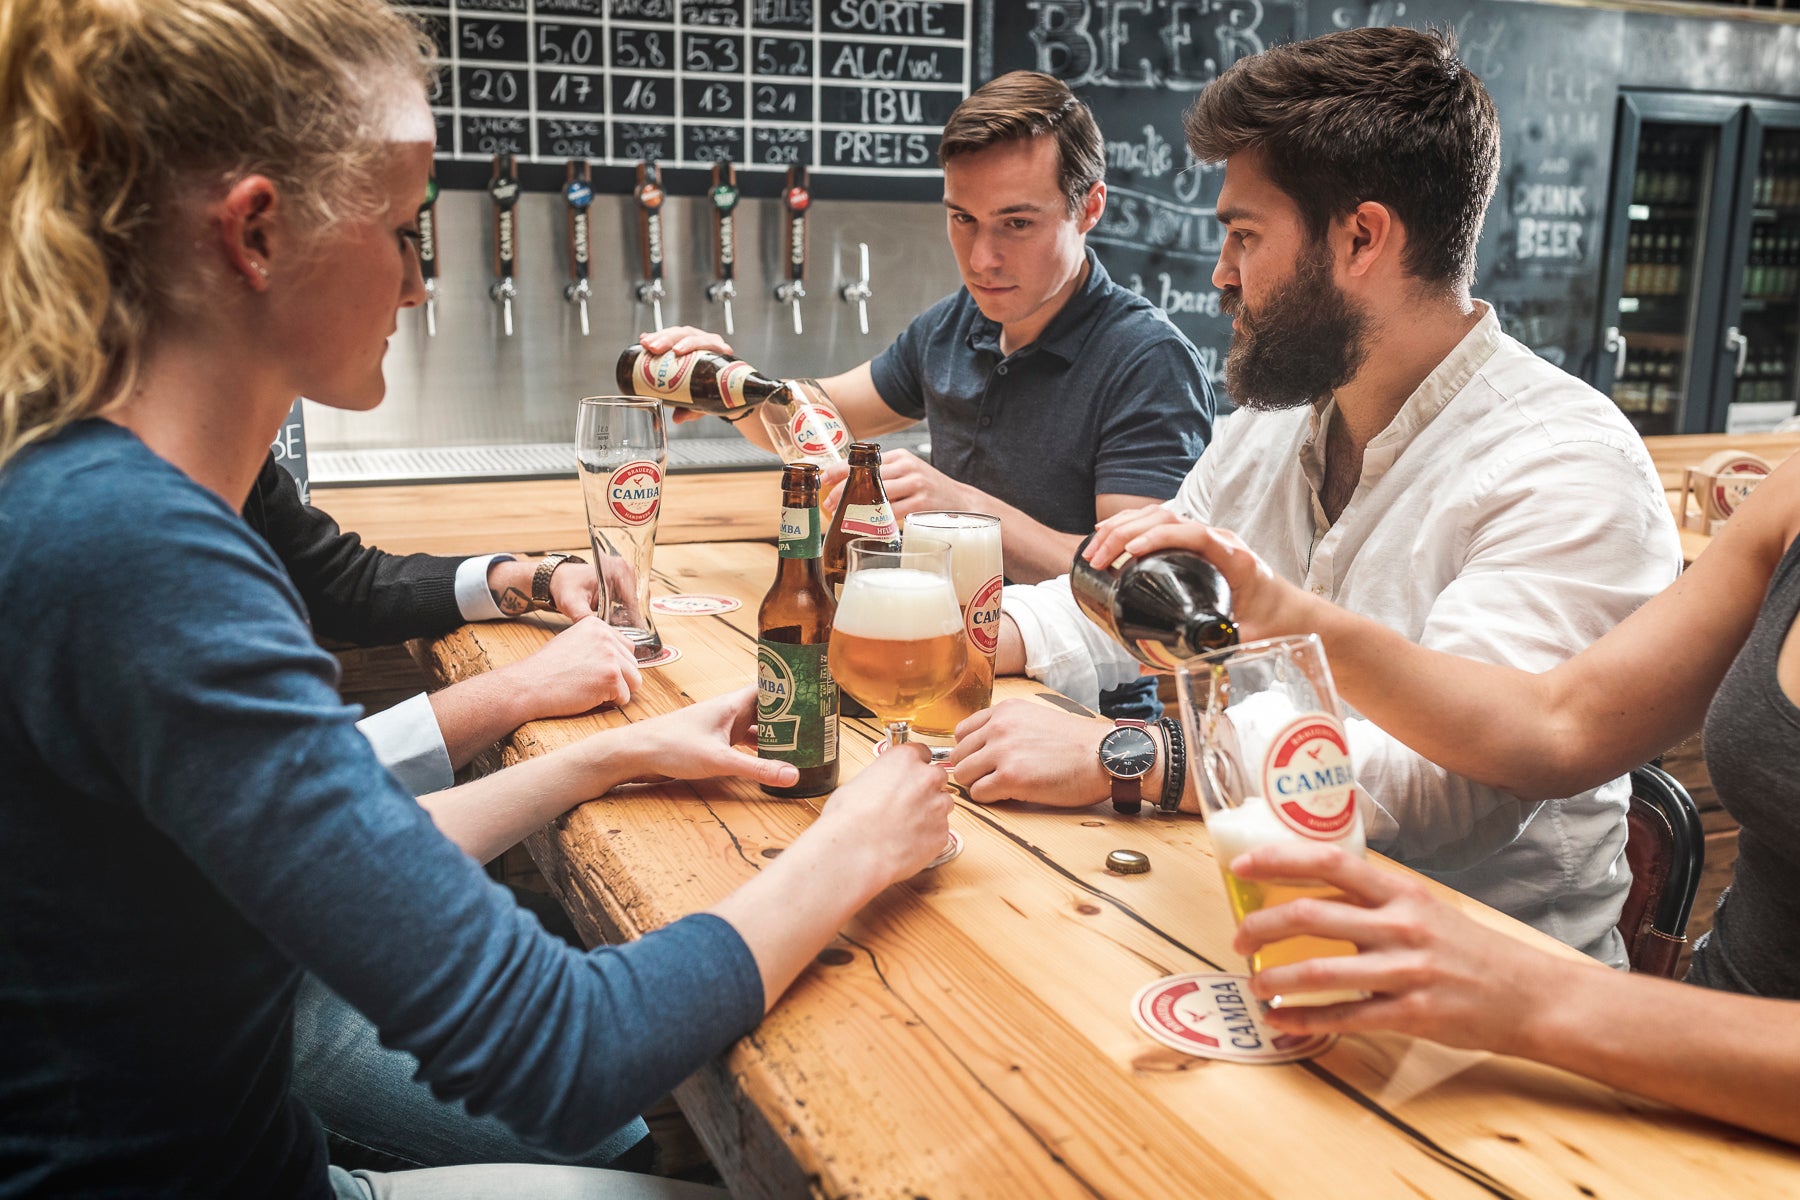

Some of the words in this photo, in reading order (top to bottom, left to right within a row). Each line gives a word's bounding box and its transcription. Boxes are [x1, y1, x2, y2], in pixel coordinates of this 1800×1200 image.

[831, 0, 946, 35] SORTE
[462, 23, 505, 51] 5,6
[540, 25, 593, 64] 5,0
[616, 31, 666, 69] 5,8
[687, 35, 739, 72] 5,3
[469, 69, 518, 103] 20
[550, 74, 592, 104] 17
[622, 79, 657, 110] 16
[698, 83, 733, 112] 13
[756, 86, 796, 113] 21
[861, 88, 923, 124] IBU
[834, 131, 930, 164] PREIS
[1516, 217, 1583, 260] BEER
[797, 421, 841, 443] CABA
[612, 486, 659, 500] CAMBA
[779, 523, 801, 535] MBA
[973, 608, 1001, 625] CAM
[759, 678, 786, 695] MBA
[1210, 982, 1262, 1050] CAMBA
